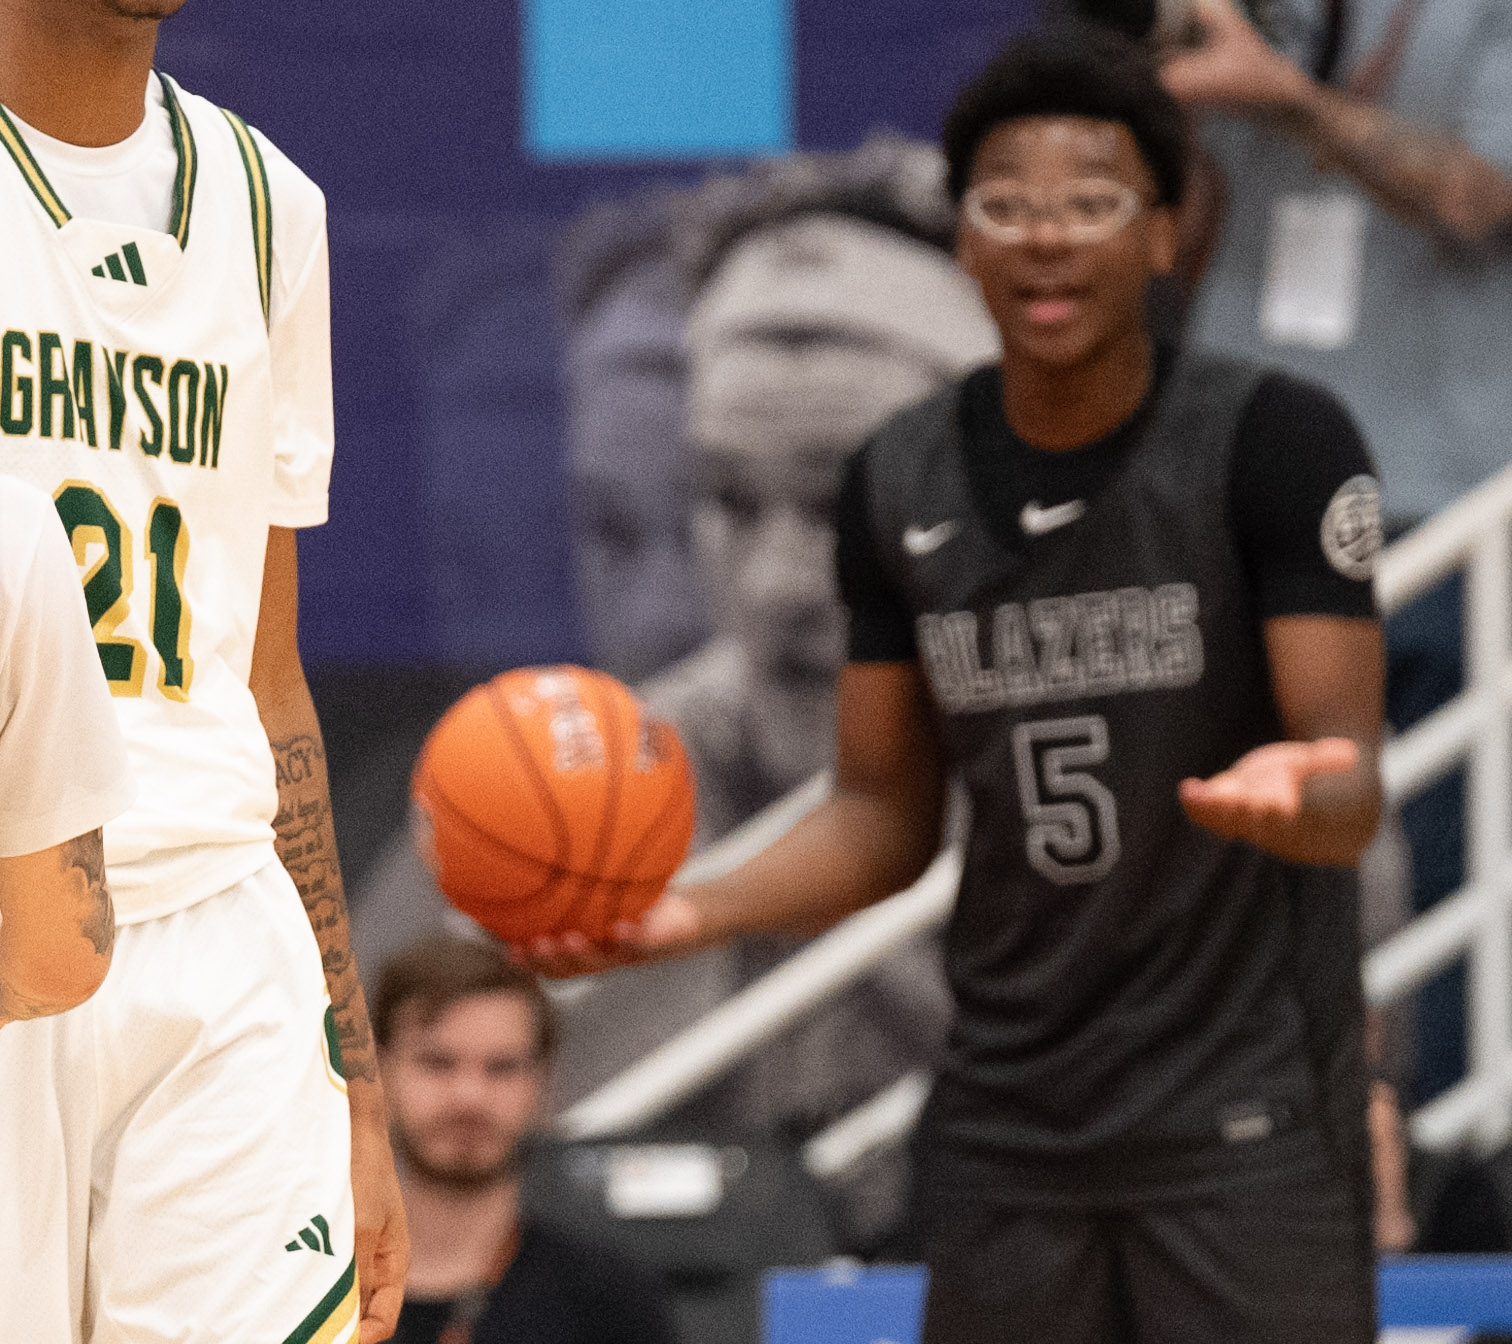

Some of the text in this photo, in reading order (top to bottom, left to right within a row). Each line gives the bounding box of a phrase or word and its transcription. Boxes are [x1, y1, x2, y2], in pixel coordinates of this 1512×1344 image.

[50, 478, 195, 704] 21
[914, 580, 1206, 716] BLAZERS
[1010, 713, 1121, 885] 5
